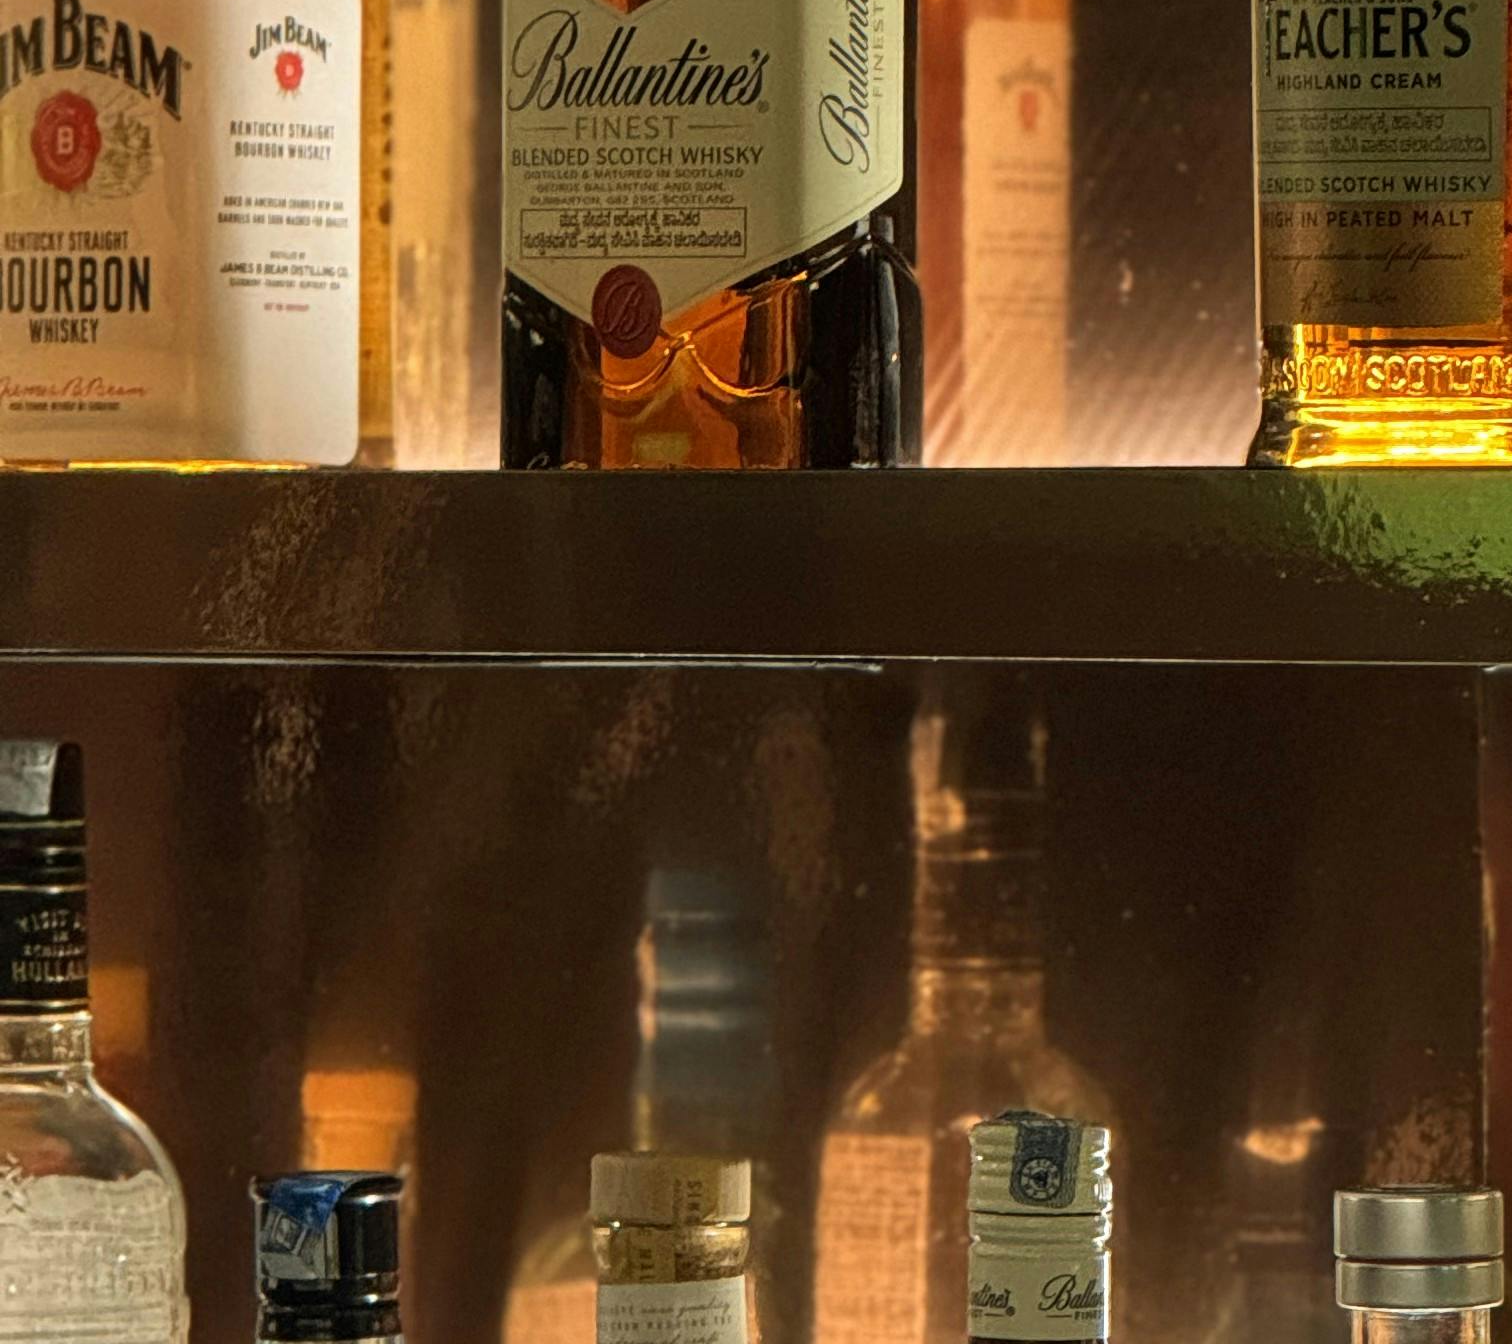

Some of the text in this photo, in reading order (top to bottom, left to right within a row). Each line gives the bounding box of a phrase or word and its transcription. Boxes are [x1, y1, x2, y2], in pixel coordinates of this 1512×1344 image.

[249, 16, 327, 63] JIM BEAM
[508, 10, 771, 113] Ballantine's
[872, 3, 886, 100] FINEST
[1277, 72, 1442, 91] HIGHLAND CREAM
[230, 119, 336, 140] KENTUCKY STRAIGHT
[574, 116, 682, 141] FINEST
[234, 141, 332, 161] BOURBON WHISKEY
[511, 145, 765, 167] BLENDED SCOTCH WHISKY
[593, 168, 652, 180] MATURED
[656, 168, 670, 179] IN
[674, 168, 745, 179] SCOTLAND
[1320, 174, 1492, 192] SCOTCH WHISKY
[583, 181, 660, 193] BALLANTINE
[663, 181, 692, 192] AND
[1301, 210, 1318, 228] IN
[1326, 209, 1402, 227] PEATED
[1413, 208, 1474, 227] MALT
[4, 230, 129, 252] KENTUCKY STRAIGHT
[0, 256, 150, 313] OURBON
[28, 318, 99, 344] WHISKEY
